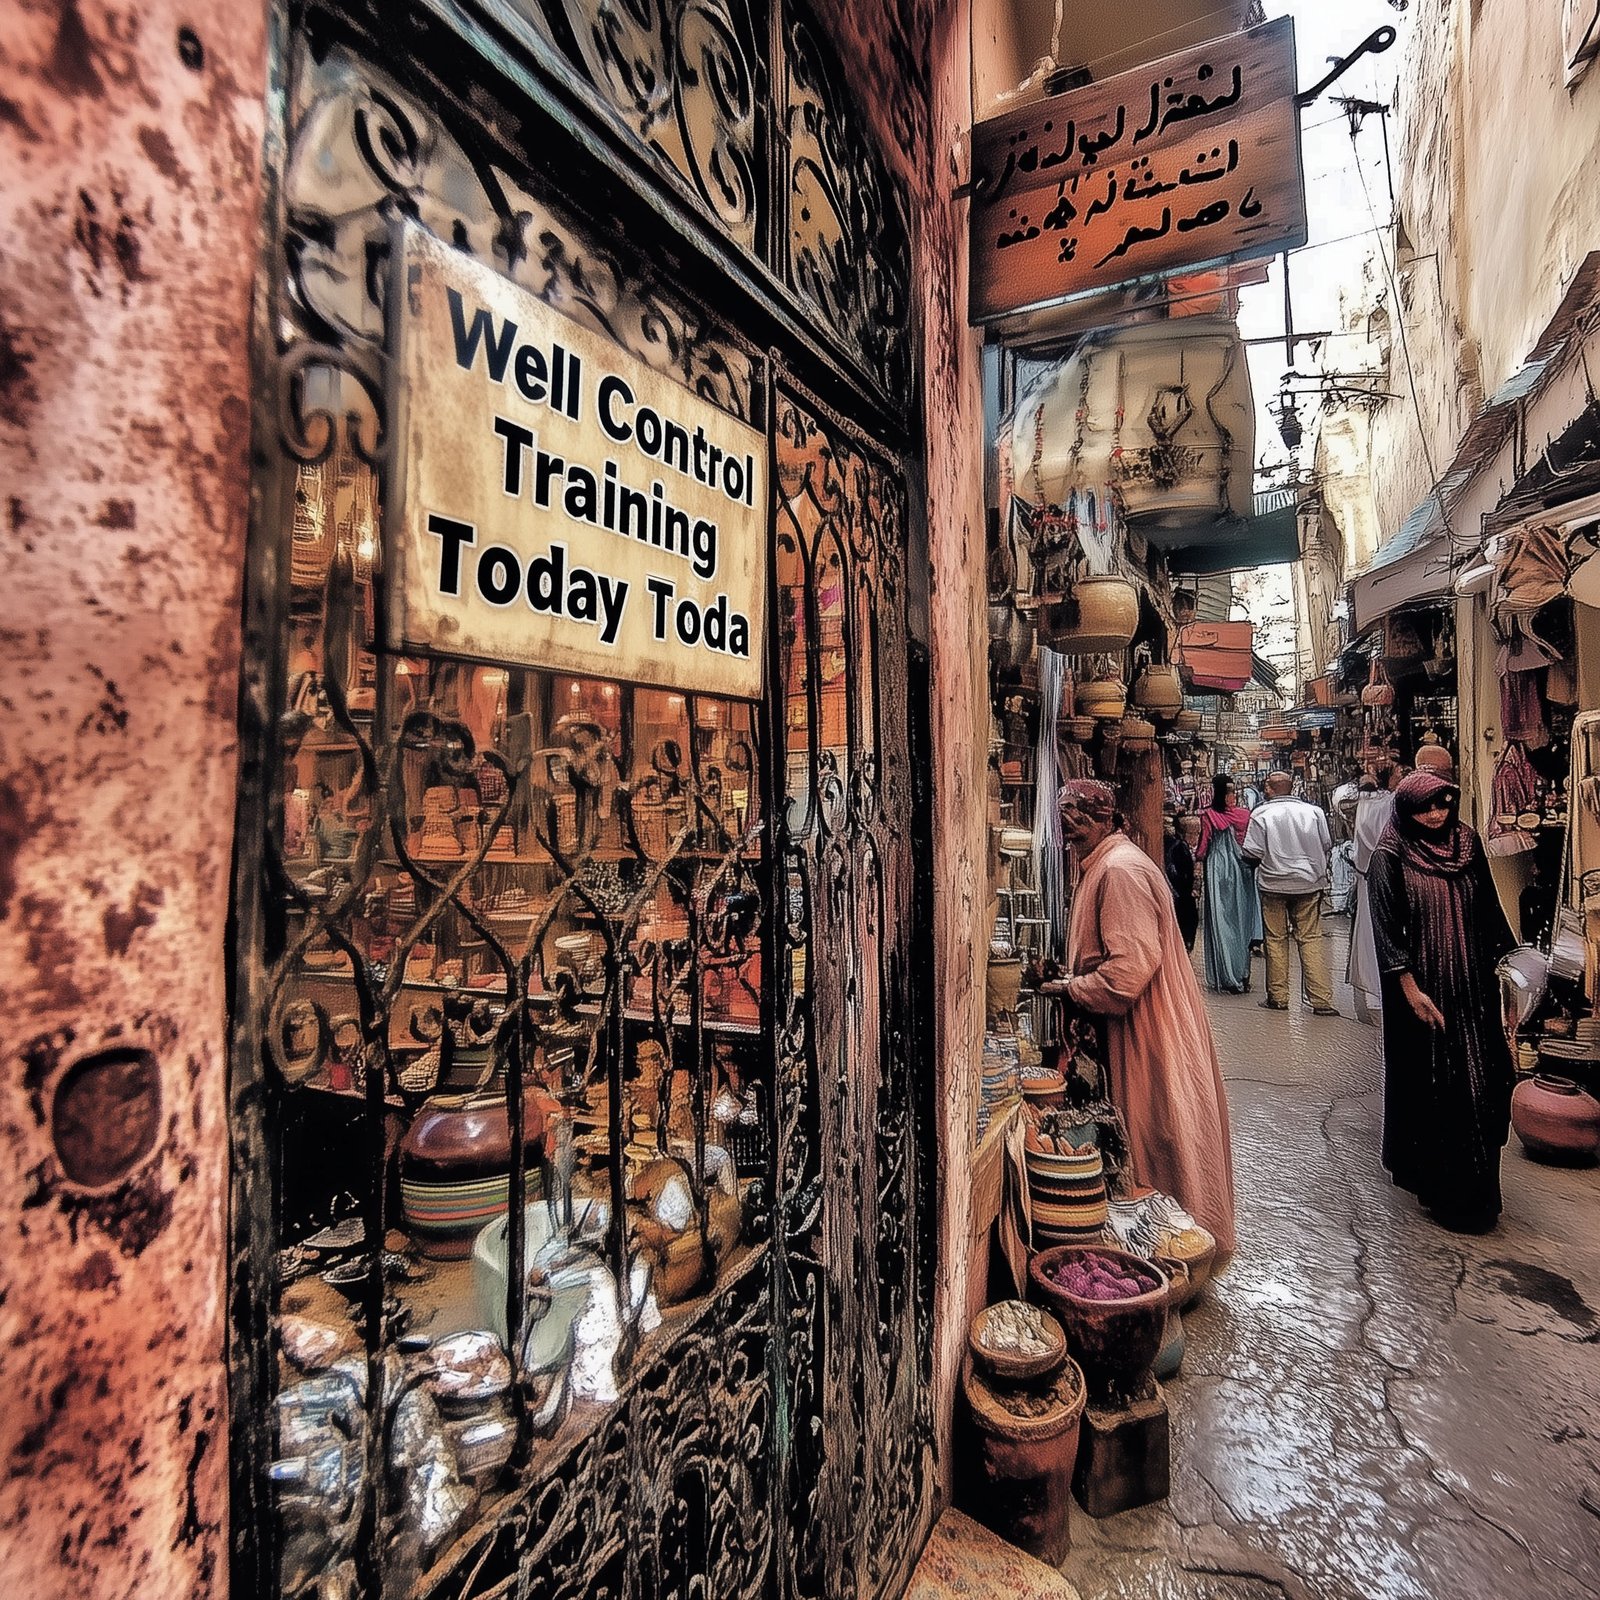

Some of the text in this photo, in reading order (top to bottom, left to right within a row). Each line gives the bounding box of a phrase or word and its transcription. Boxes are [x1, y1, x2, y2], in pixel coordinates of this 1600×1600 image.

[447, 287, 753, 506] Well Control
[495, 417, 717, 579] Training
[428, 515, 749, 657] Today Toda
